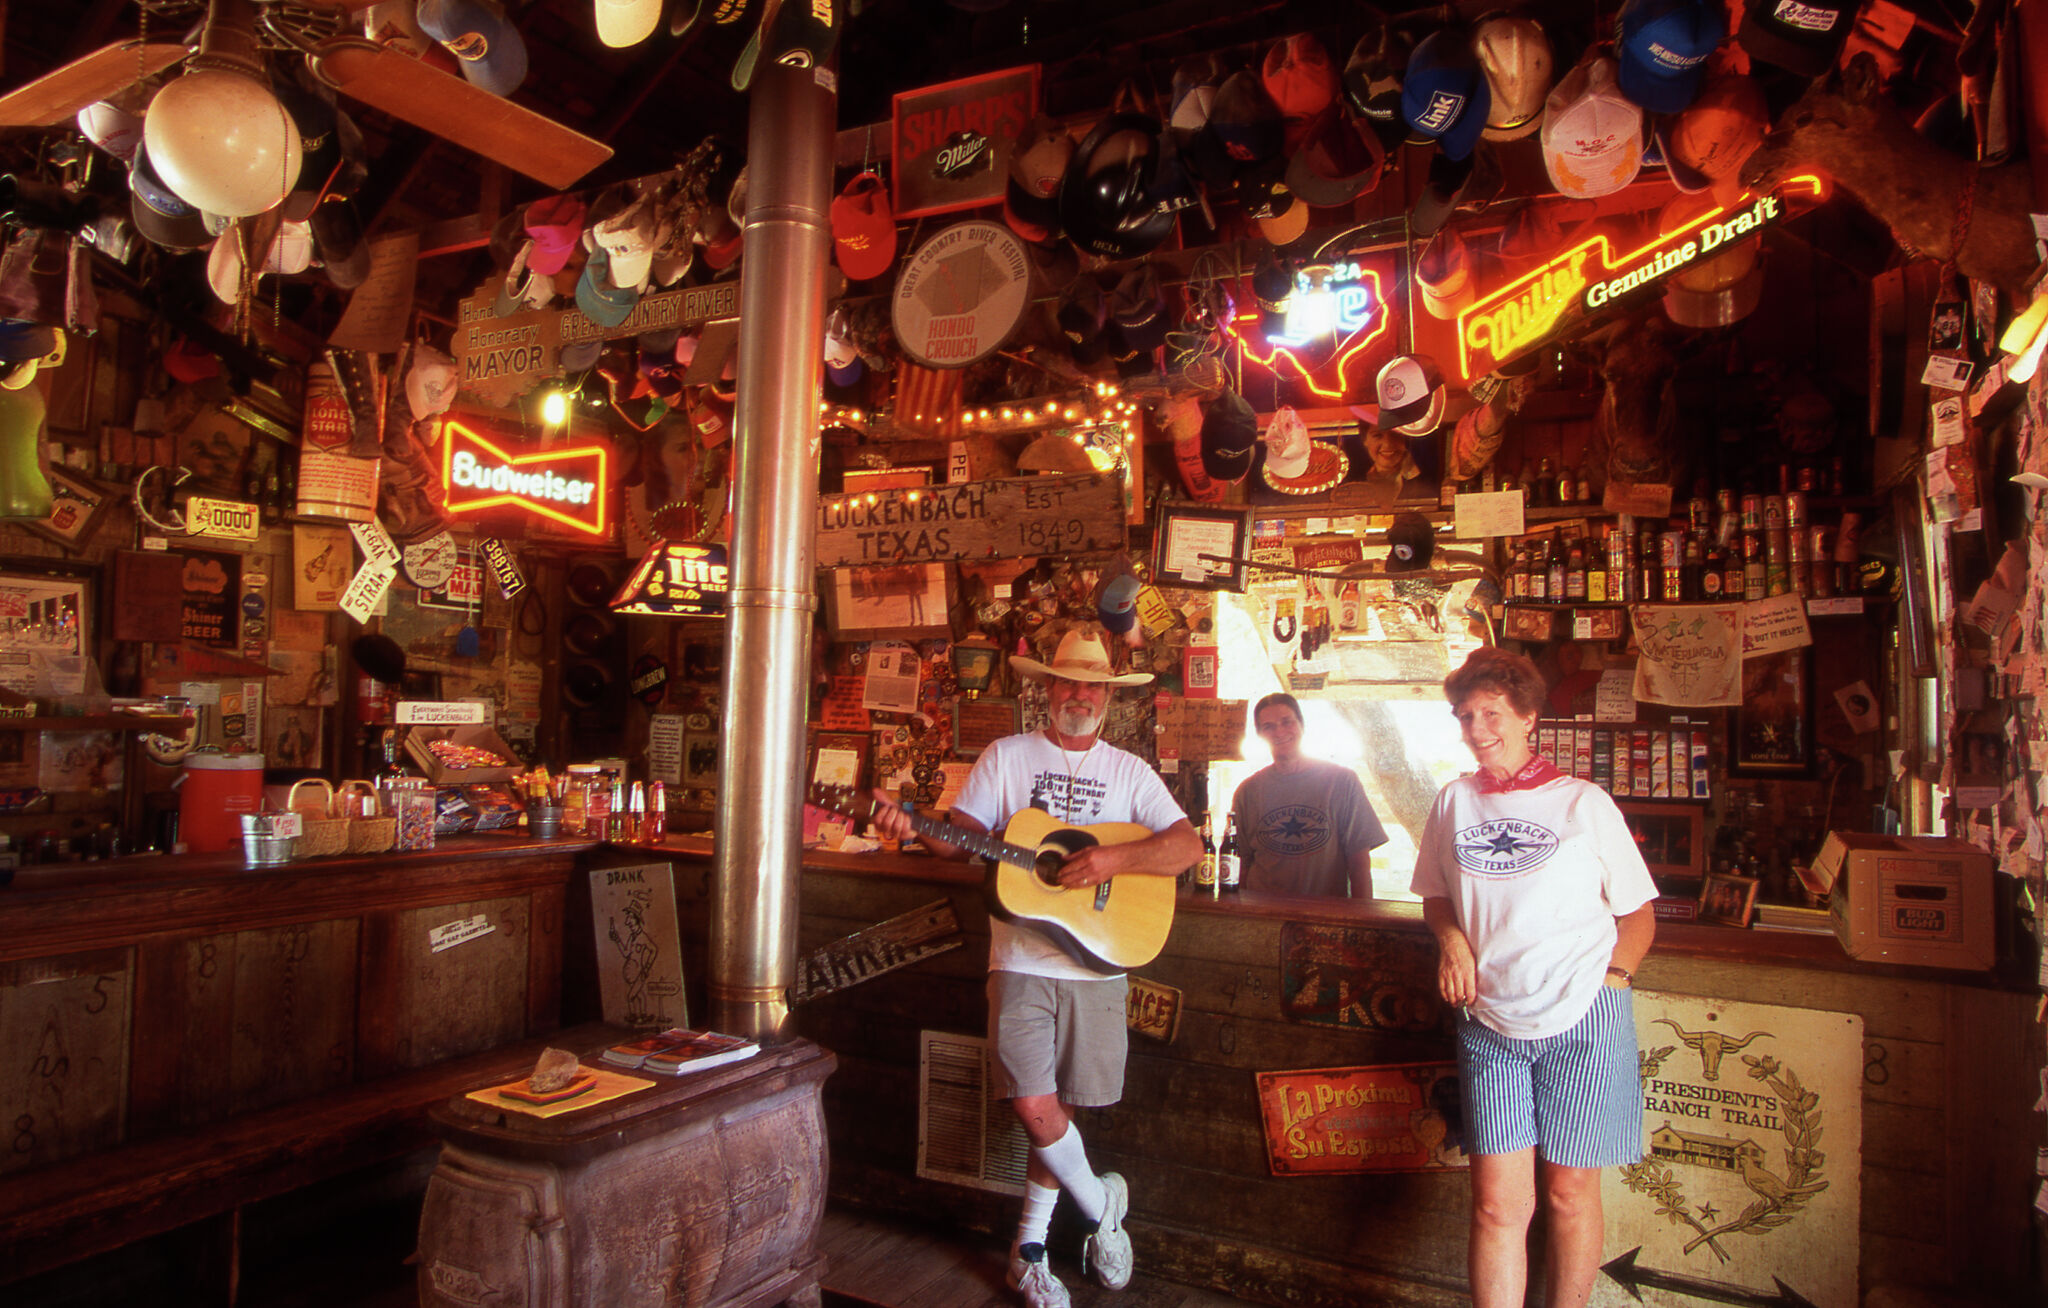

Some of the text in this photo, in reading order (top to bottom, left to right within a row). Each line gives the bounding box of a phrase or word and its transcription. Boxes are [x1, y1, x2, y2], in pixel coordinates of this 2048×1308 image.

[1420, 96, 1455, 128] Link
[936, 137, 987, 174] Miller
[901, 228, 1026, 299] GREAT COUNTRY RIVER FESTIVAL
[1586, 194, 1779, 307] Genuine Draft
[686, 286, 735, 319] RIVER
[1467, 251, 1587, 360] Miller
[928, 316, 976, 339] HONDO
[466, 345, 544, 381] MAYOR
[925, 337, 978, 360] CROUCH
[311, 421, 348, 434] STAR
[312, 408, 349, 420] LONE
[452, 450, 594, 504] Budweiser
[822, 488, 988, 531] LUCKENBACH
[1025, 491, 1065, 510] EST
[857, 527, 951, 559] TEXAS
[1018, 519, 1085, 549] 1849
[486, 539, 520, 590] 398767
[667, 558, 727, 588] Lite
[181, 625, 222, 639] BEER
[1754, 632, 1769, 643] BUT
[427, 713, 473, 722] LUCKENBACH
[1263, 808, 1325, 828] LUCKENBACH
[1463, 822, 1548, 841] LUCKENBACH
[607, 870, 645, 886] DRANK
[1483, 860, 1516, 871] TEXAS
[1899, 918, 1943, 930] LIGHT
[1905, 909, 1938, 920] BUD
[1278, 1082, 1411, 1137] La Próxima
[1651, 1079, 1778, 1112] PRESIDENT'S
[1645, 1096, 1784, 1132] RANCH TRAIL
[1288, 1126, 1418, 1164] Su Esposa
